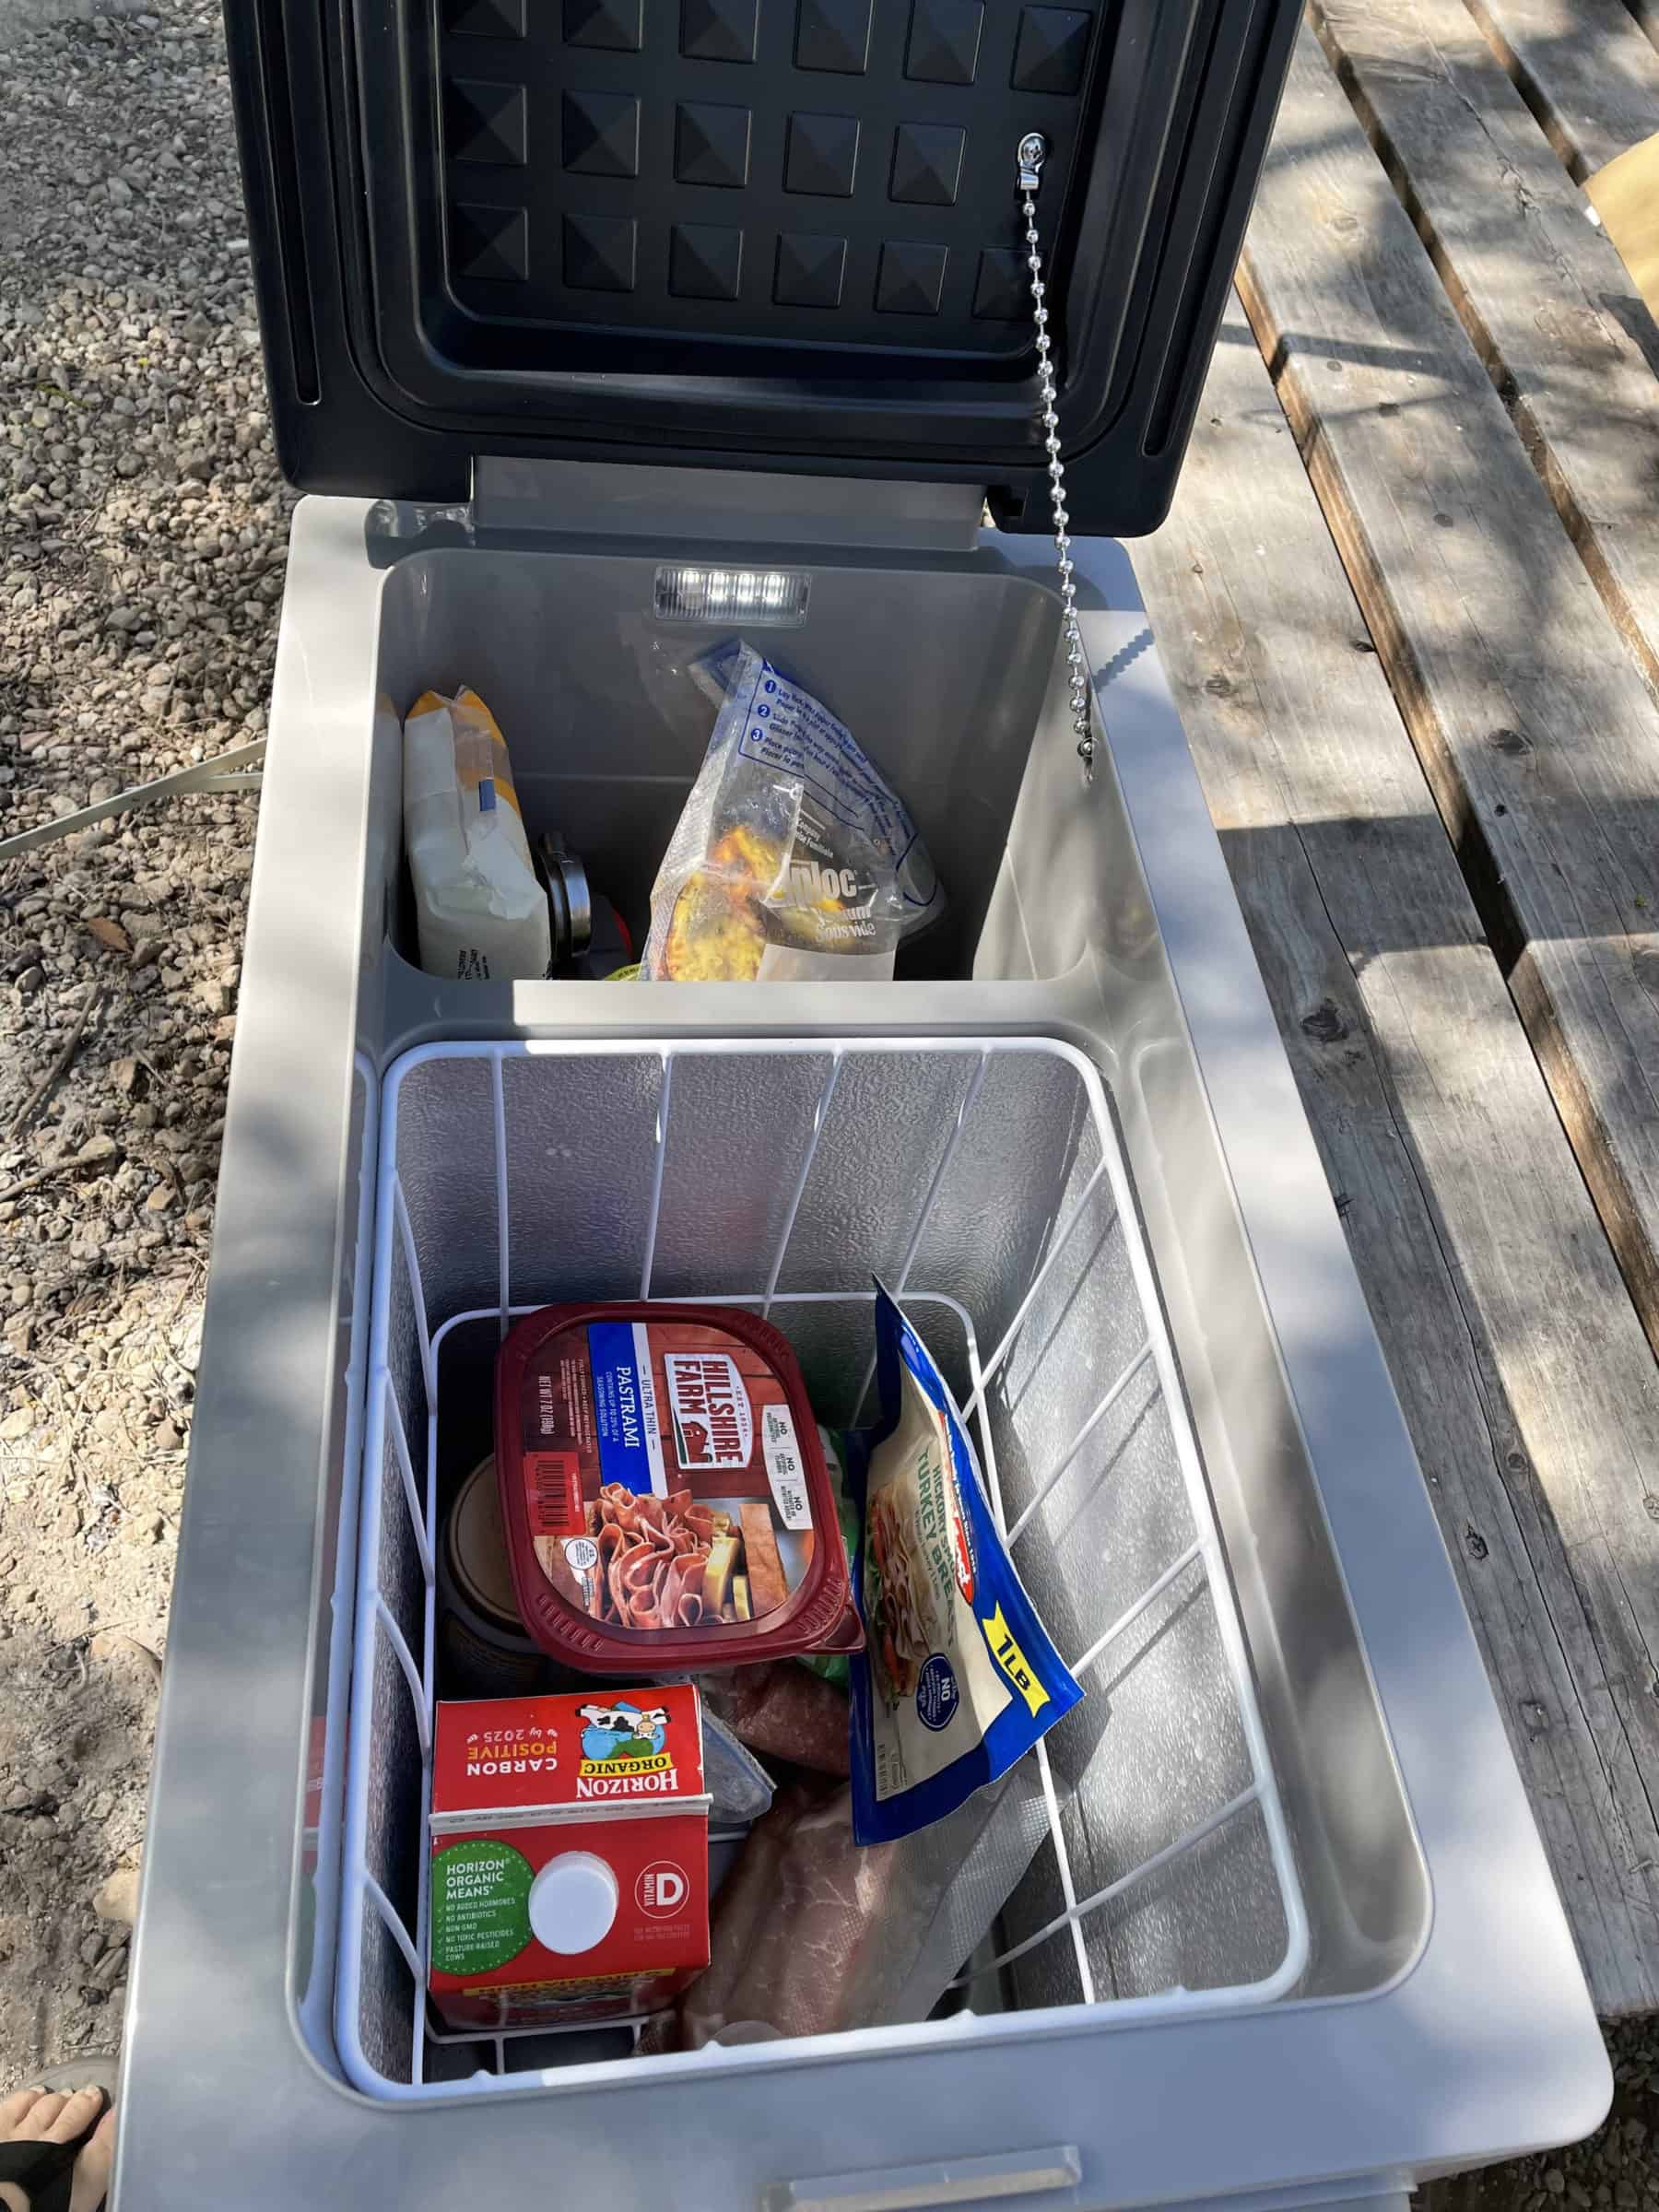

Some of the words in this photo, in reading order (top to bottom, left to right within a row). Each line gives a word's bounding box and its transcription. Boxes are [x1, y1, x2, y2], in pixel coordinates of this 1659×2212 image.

[537, 1375, 550, 1387] NET
[605, 1371, 614, 1398] CONTAINS
[673, 1359, 705, 1415] FARM
[538, 1387, 552, 1398] WT
[595, 1376, 606, 1407] SEASONING
[641, 1379, 653, 1409] ULTRA
[539, 1404, 553, 1414] OZ
[616, 1366, 640, 1448] PASTRAMI
[702, 1360, 744, 1464] HILLSHIRE
[599, 1408, 609, 1437] SOLUTION
[645, 1411, 657, 1435] THIN
[778, 1421, 788, 1435] NO
[786, 1456, 794, 1471] NO
[918, 1446, 936, 1540] TURKEY
[933, 1465, 947, 1534] HICKORY
[794, 1496, 803, 1511] NO
[941, 1676, 952, 1702] NO
[484, 1728, 524, 1743] 2025
[530, 1727, 542, 1738] by
[467, 1741, 558, 1760] POSITIVE
[466, 1758, 558, 1776] CARBON
[583, 1757, 668, 1775] ORGANIC
[576, 1769, 678, 1798] HORIZON
[446, 1872, 505, 1888] ORGANIC
[644, 1873, 655, 1907] VITAMIN
[656, 1872, 684, 1906] D
[456, 1901, 478, 1912] ADDED
[479, 1898, 516, 1909] HORMONES
[457, 1910, 497, 1922] ANTIBIOTICS
[457, 1933, 476, 1942] TOXIC
[477, 1929, 514, 1940] PESTICIDES
[445, 1953, 465, 1962] COWS
